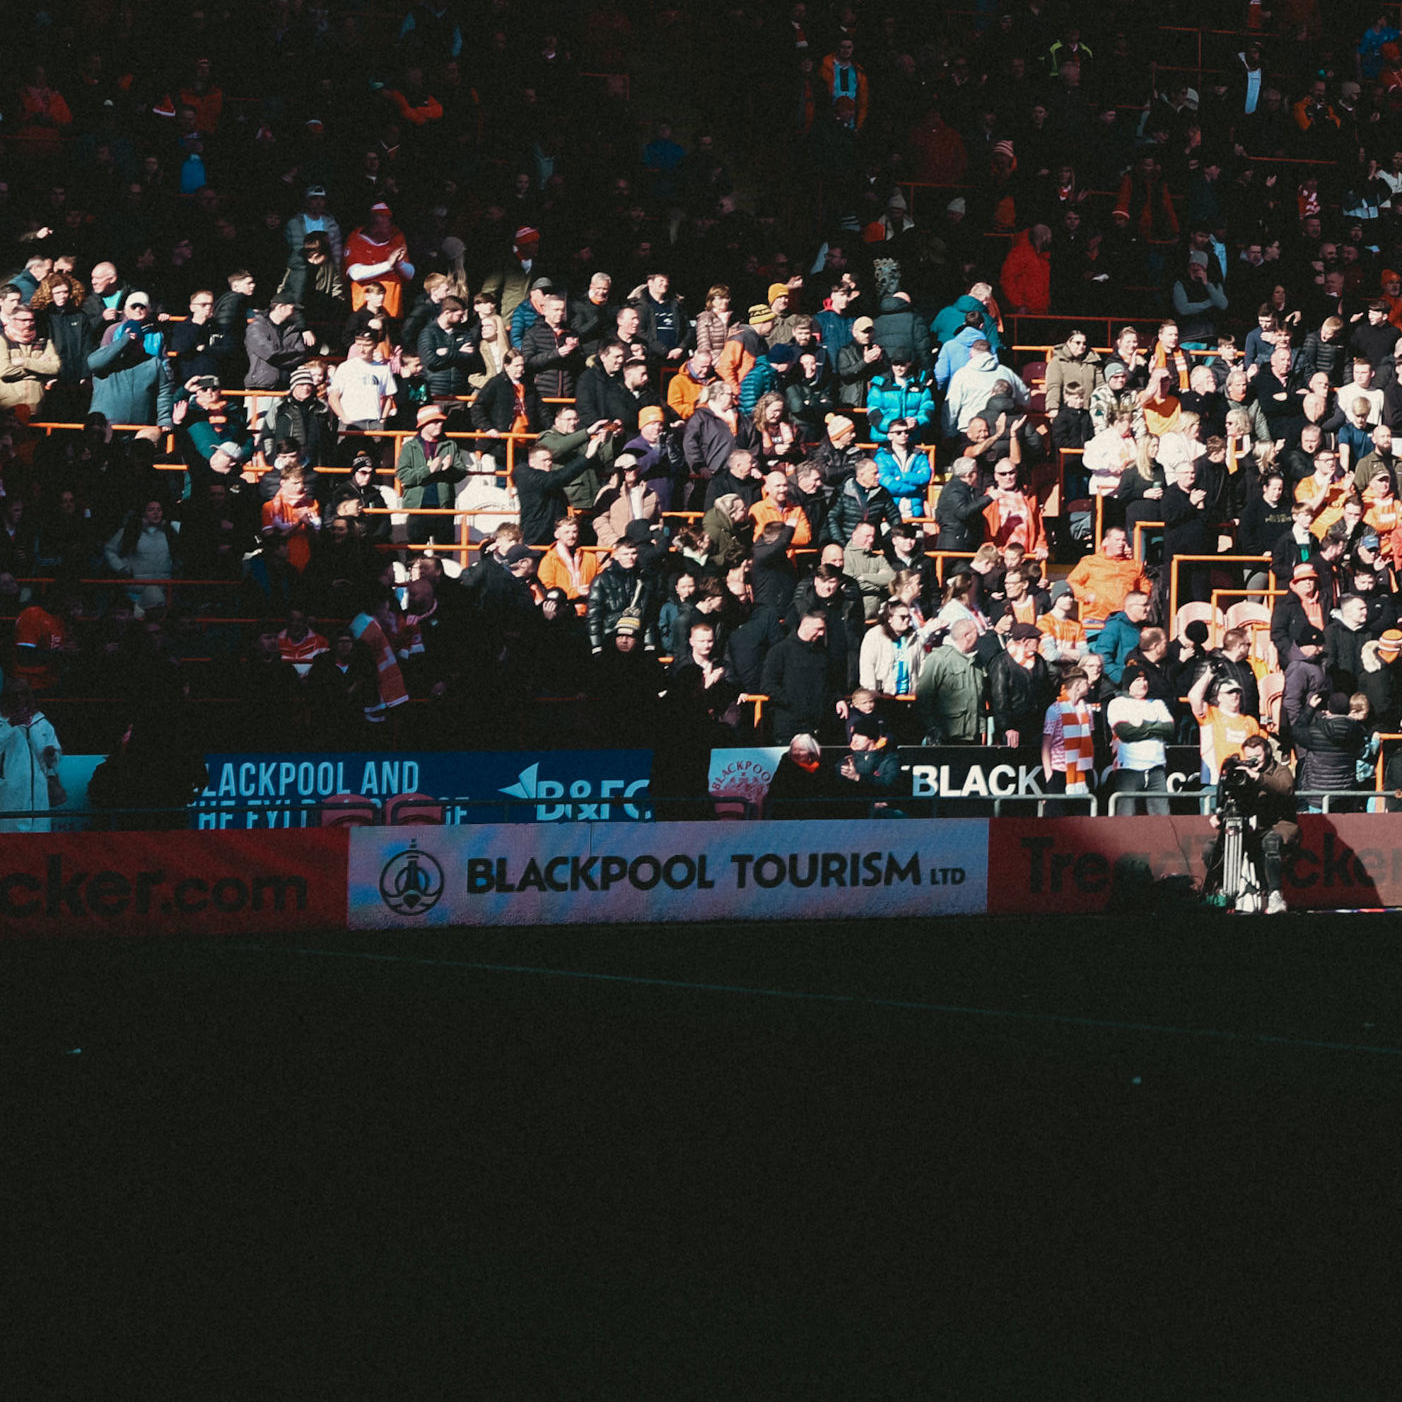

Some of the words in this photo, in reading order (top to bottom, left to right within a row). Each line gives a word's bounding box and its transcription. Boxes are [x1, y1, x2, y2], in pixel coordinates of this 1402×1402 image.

[192, 761, 351, 797] LACKPOOL
[360, 760, 419, 795] AND
[711, 760, 771, 790] BLACKPOO
[536, 779, 652, 821] B&FC
[467, 852, 714, 894] BLACKPOOL
[731, 851, 922, 889] TOURISM
[930, 867, 966, 887] LTD
